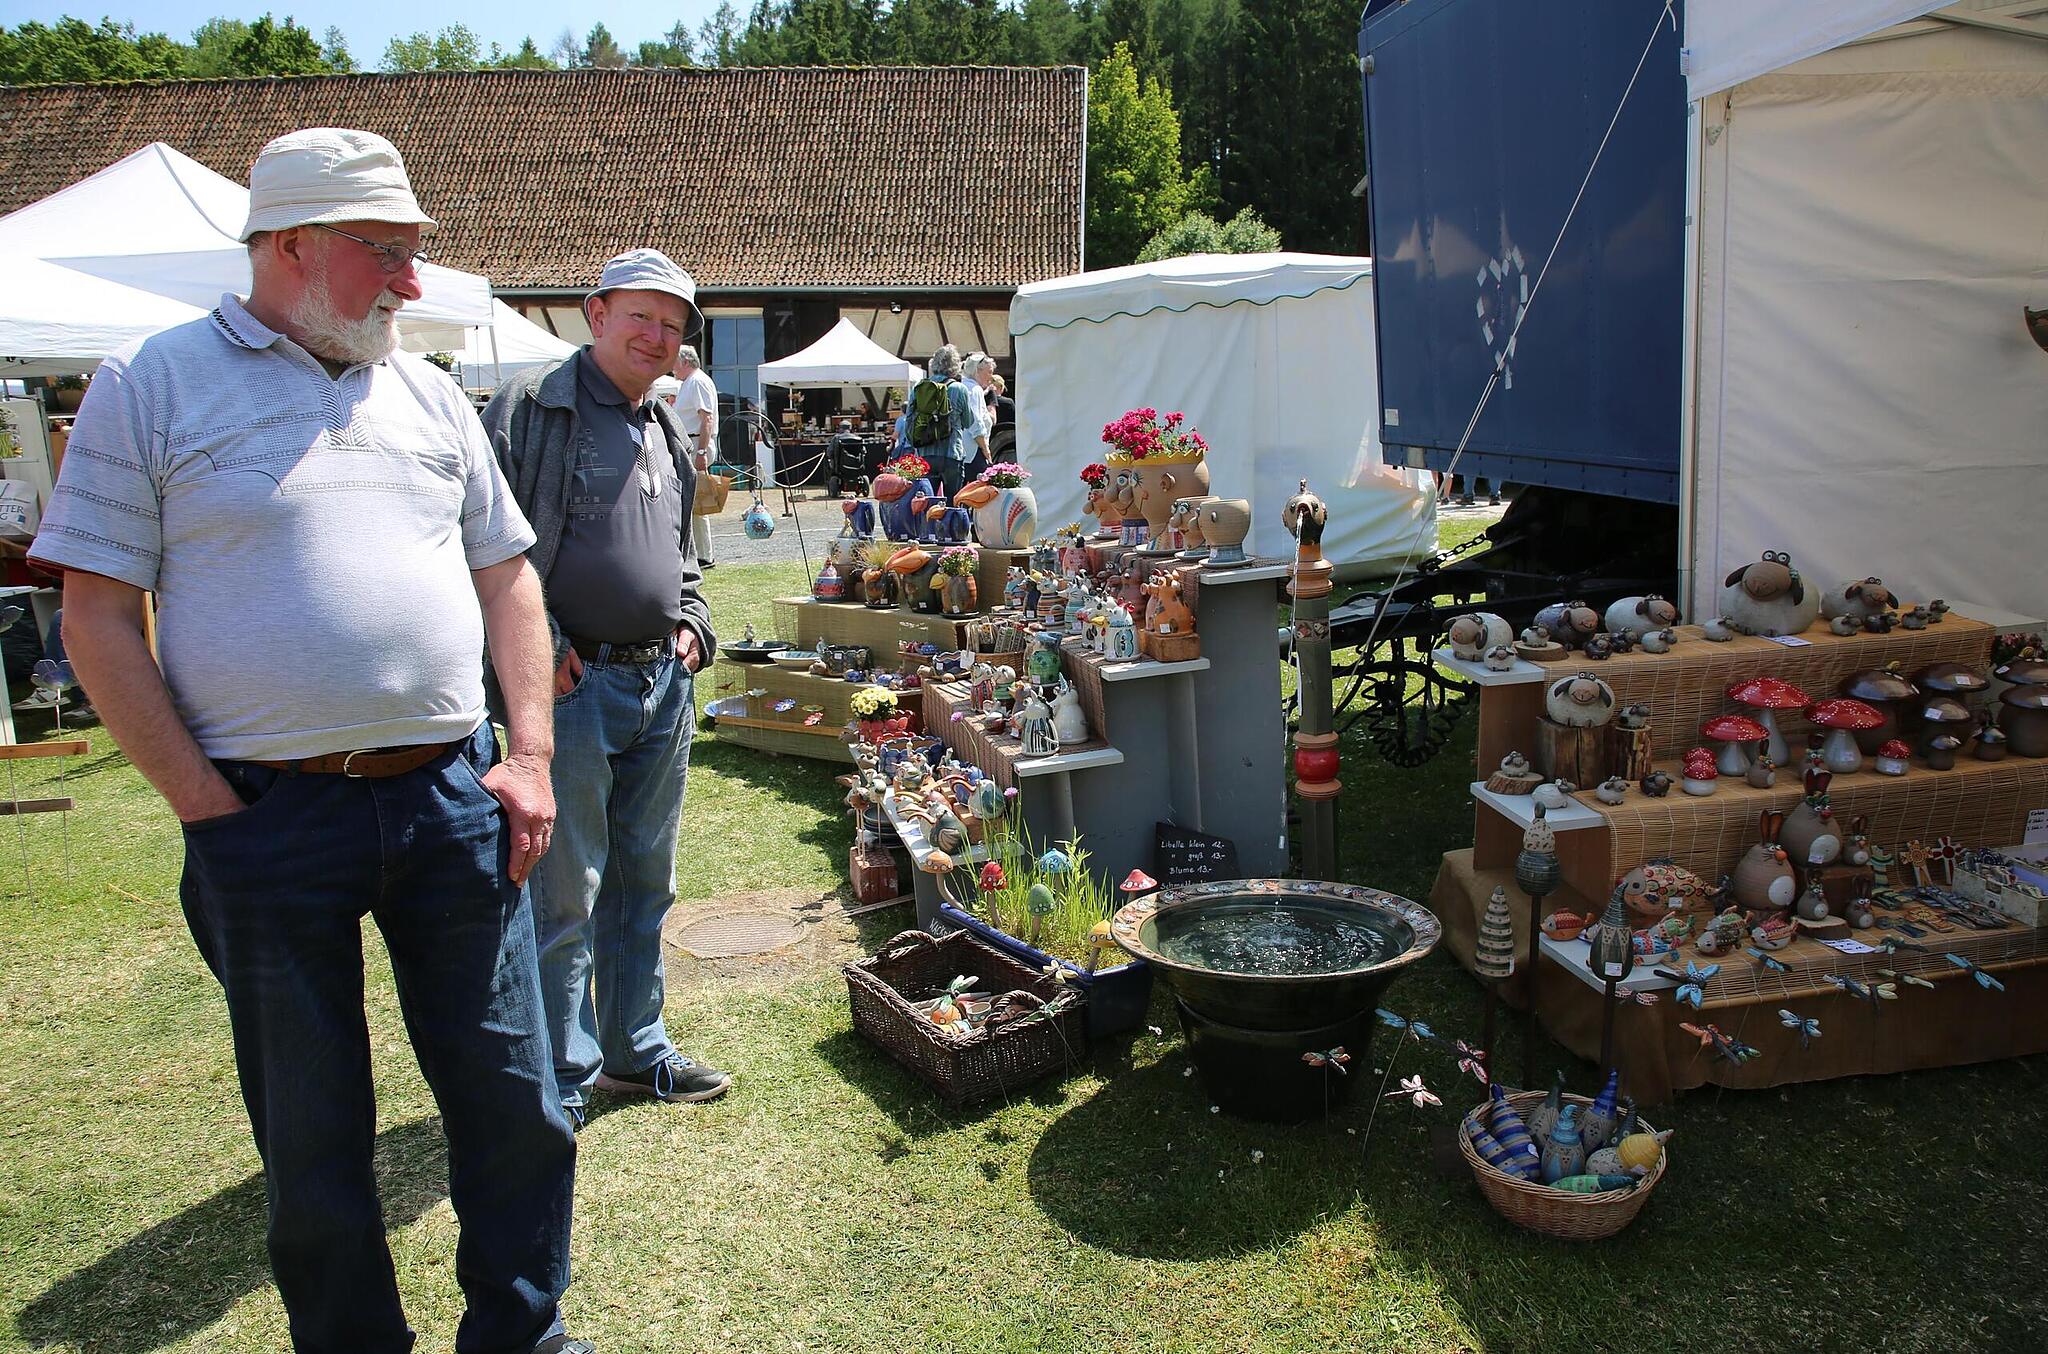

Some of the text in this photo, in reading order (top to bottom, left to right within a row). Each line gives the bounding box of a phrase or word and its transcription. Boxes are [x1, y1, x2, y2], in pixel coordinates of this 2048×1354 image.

[775, 310, 793, 327] 7
[1161, 840, 1185, 848] Libelle
[1189, 839, 1205, 848] klein
[1169, 866, 1195, 875] Blume
